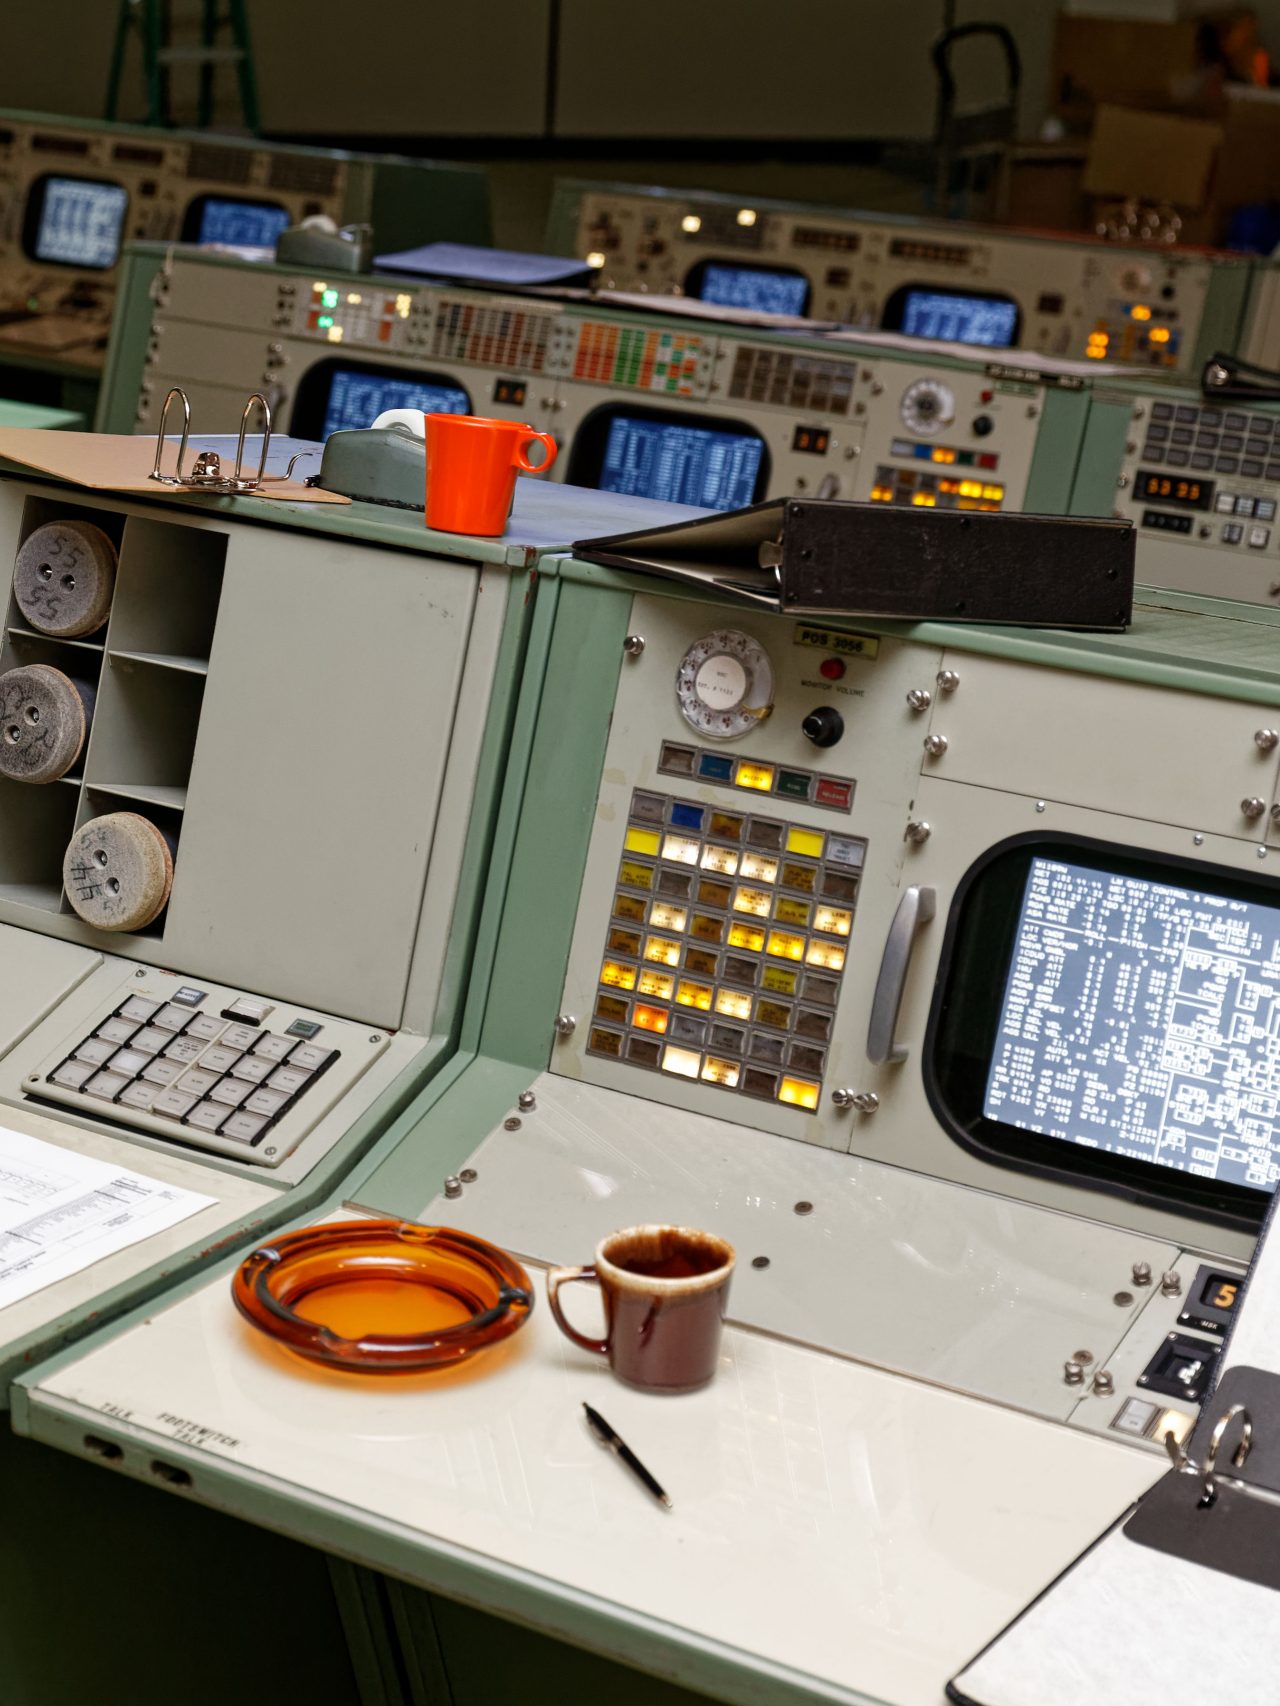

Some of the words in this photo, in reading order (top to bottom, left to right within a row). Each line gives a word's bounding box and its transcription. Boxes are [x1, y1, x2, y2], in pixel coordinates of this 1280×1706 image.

[802, 630, 828, 646] POS
[836, 685, 865, 697] VOLUME
[1214, 1283, 1238, 1309] 5
[100, 1402, 133, 1419] TALK
[157, 1412, 241, 1447] FOOTSWITCH
[173, 1429, 205, 1446] TALK
